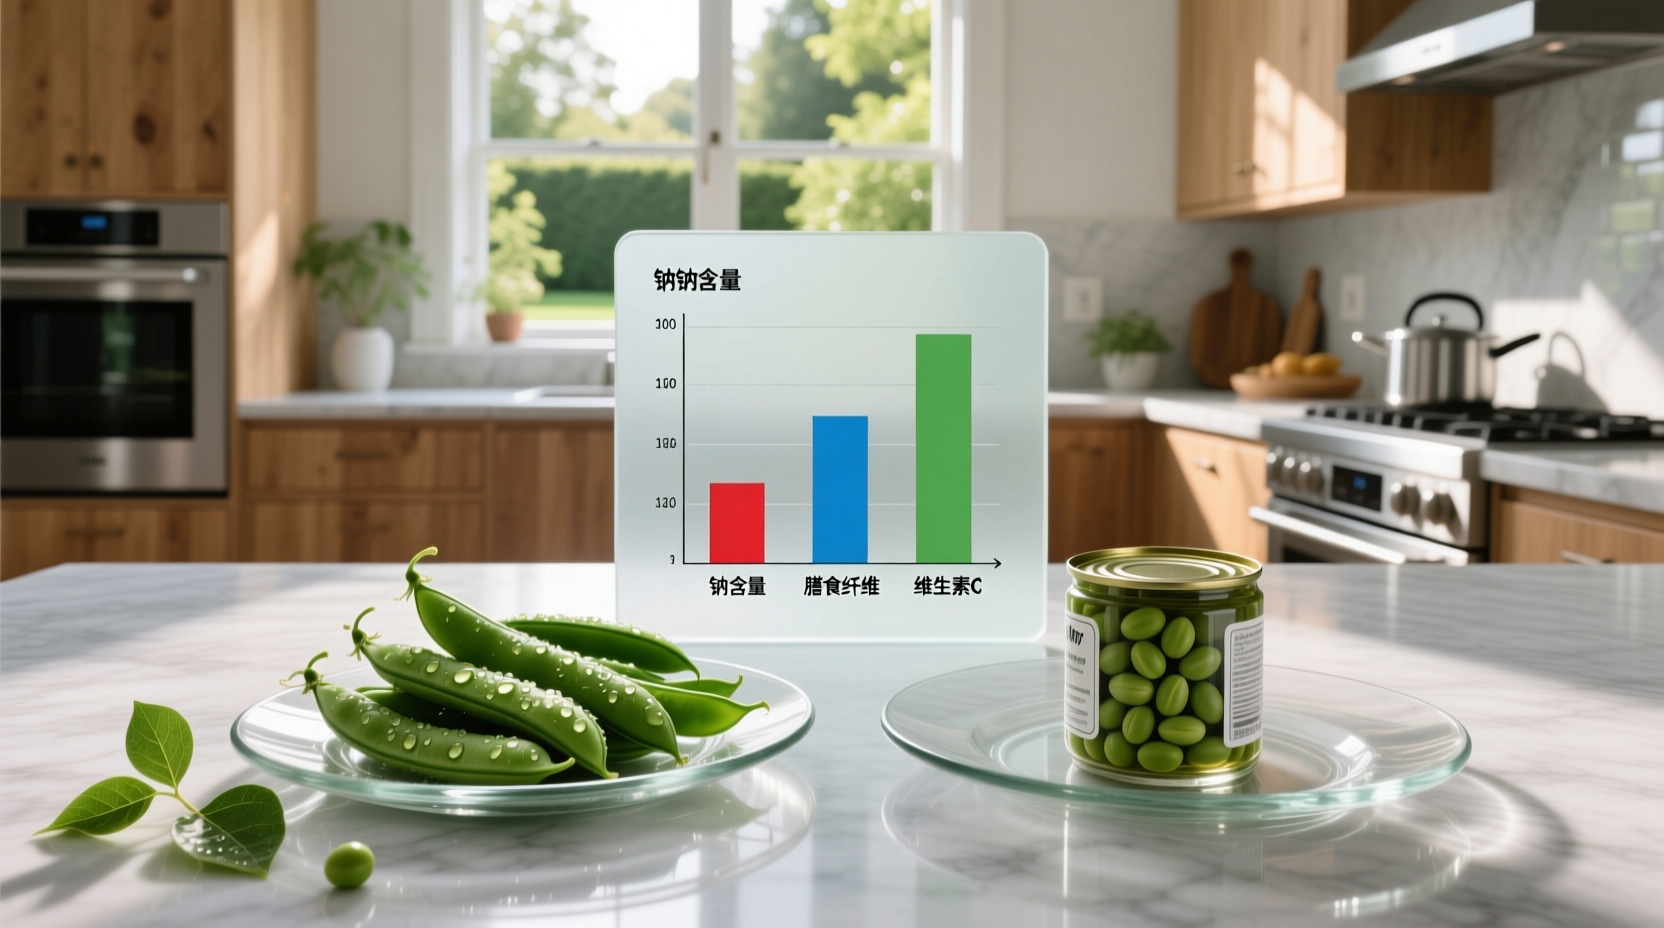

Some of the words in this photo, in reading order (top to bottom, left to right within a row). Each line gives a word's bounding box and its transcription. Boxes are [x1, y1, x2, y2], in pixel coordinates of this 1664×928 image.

[653, 267, 741, 292] 钠钠含量
[709, 575, 766, 596] 钠含量
[803, 575, 881, 597] 膳食纤维
[913, 575, 983, 596] 维生素C
